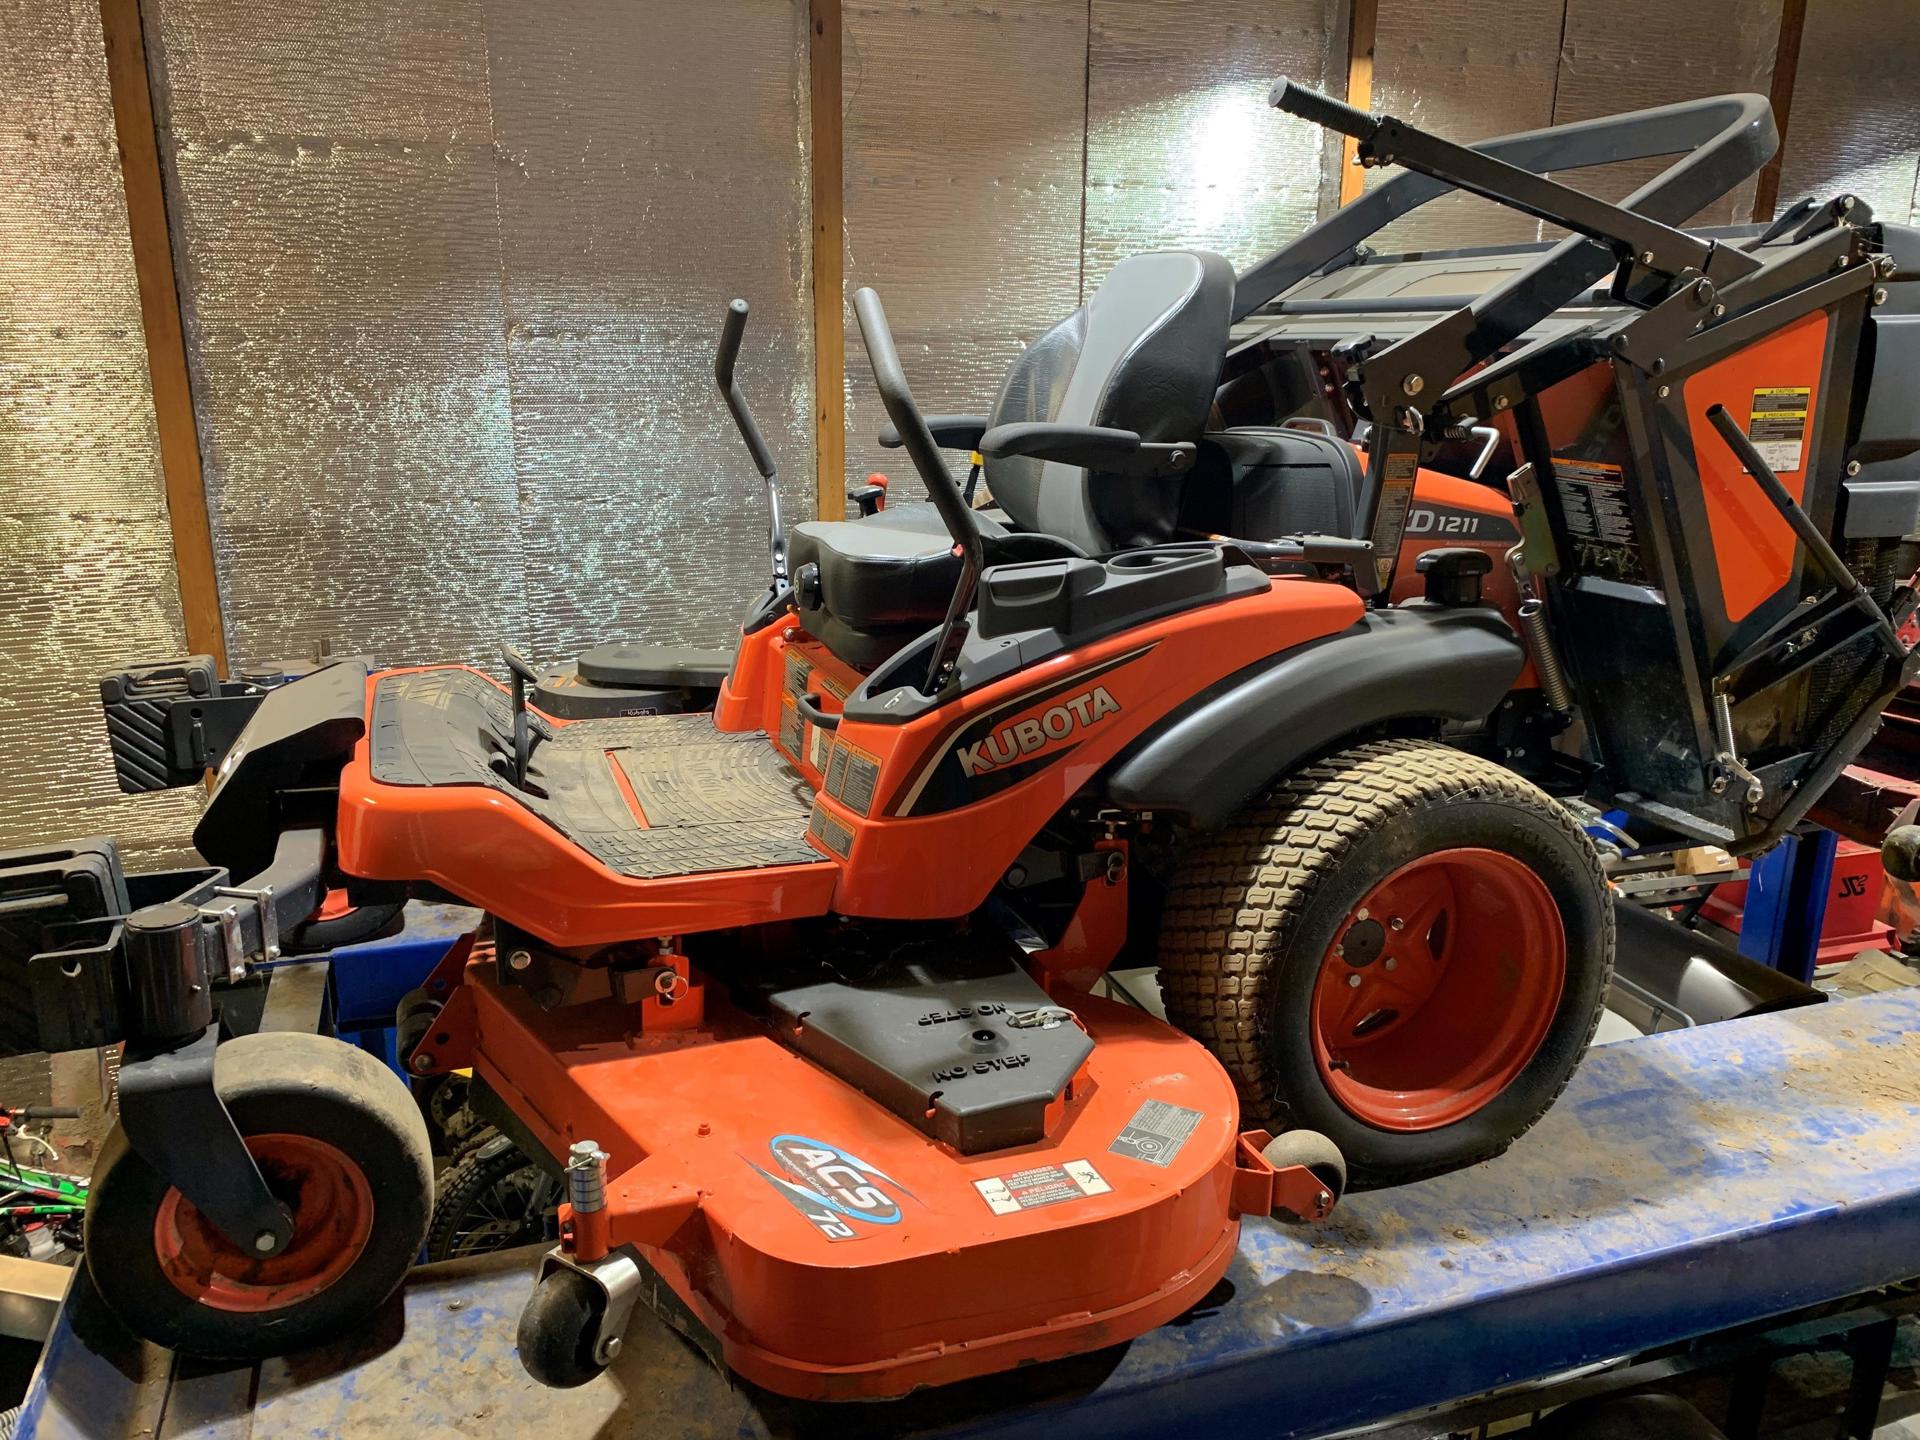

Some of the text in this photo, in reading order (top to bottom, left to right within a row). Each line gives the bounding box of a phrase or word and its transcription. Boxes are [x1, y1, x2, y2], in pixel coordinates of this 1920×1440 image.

[1438, 515, 1479, 533] 1211
[957, 686, 1122, 778] KUBOTA
[918, 1001, 1007, 1026] NO STEP
[931, 1053, 1031, 1083] NO STEP
[786, 1146, 894, 1209] ACS
[1017, 1165, 1054, 1177] DANGER
[1028, 1181, 1067, 1194] PELIGRO
[808, 1209, 855, 1239] 72
